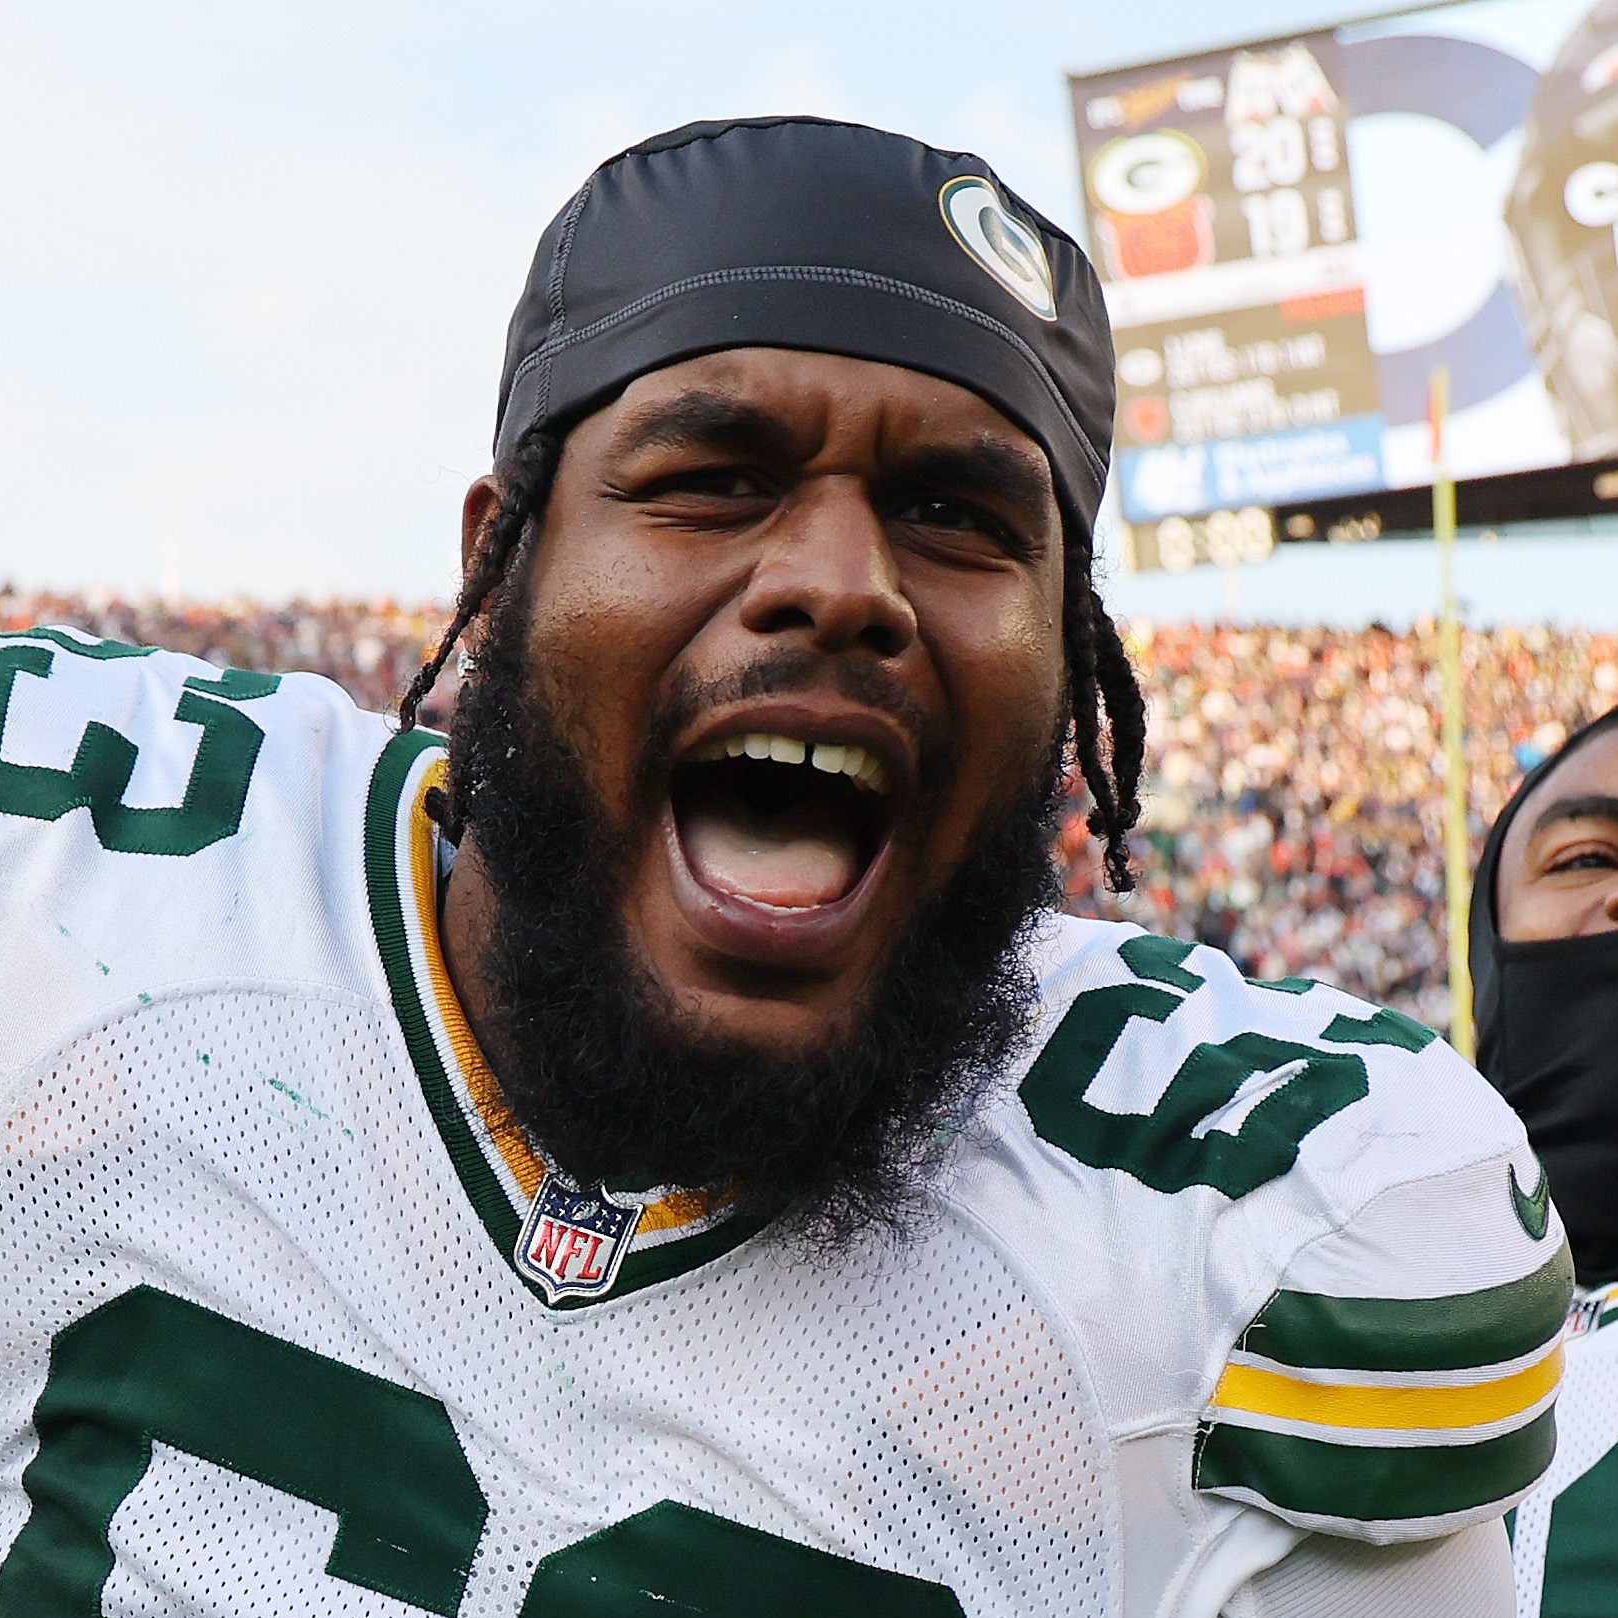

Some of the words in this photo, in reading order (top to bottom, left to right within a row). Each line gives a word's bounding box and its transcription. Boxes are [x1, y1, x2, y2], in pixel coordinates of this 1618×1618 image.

[1228, 115, 1307, 193] 20
[1241, 187, 1310, 259] 19
[1017, 935, 1437, 1200] 6
[531, 1220, 604, 1280] NFL
